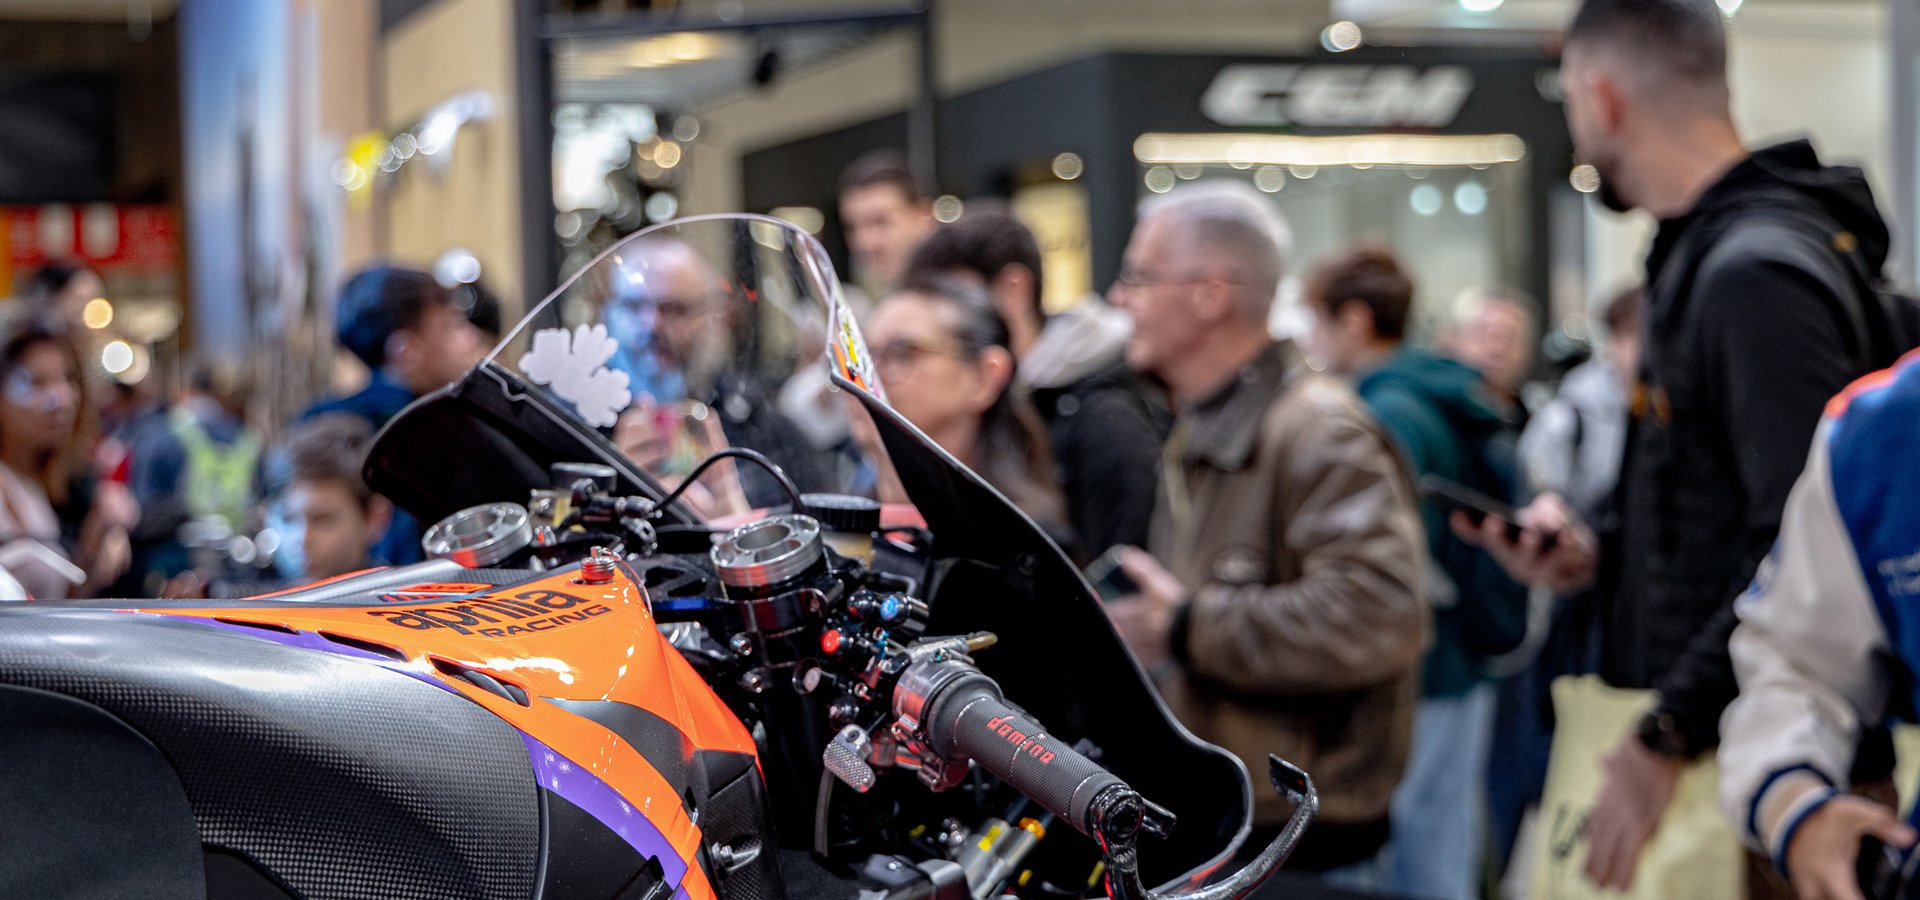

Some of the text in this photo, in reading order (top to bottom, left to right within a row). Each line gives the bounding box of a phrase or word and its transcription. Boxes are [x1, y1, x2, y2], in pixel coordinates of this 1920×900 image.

[367, 590, 591, 635] aprilia
[477, 604, 612, 638] RACING
[986, 715, 1056, 764] domino
